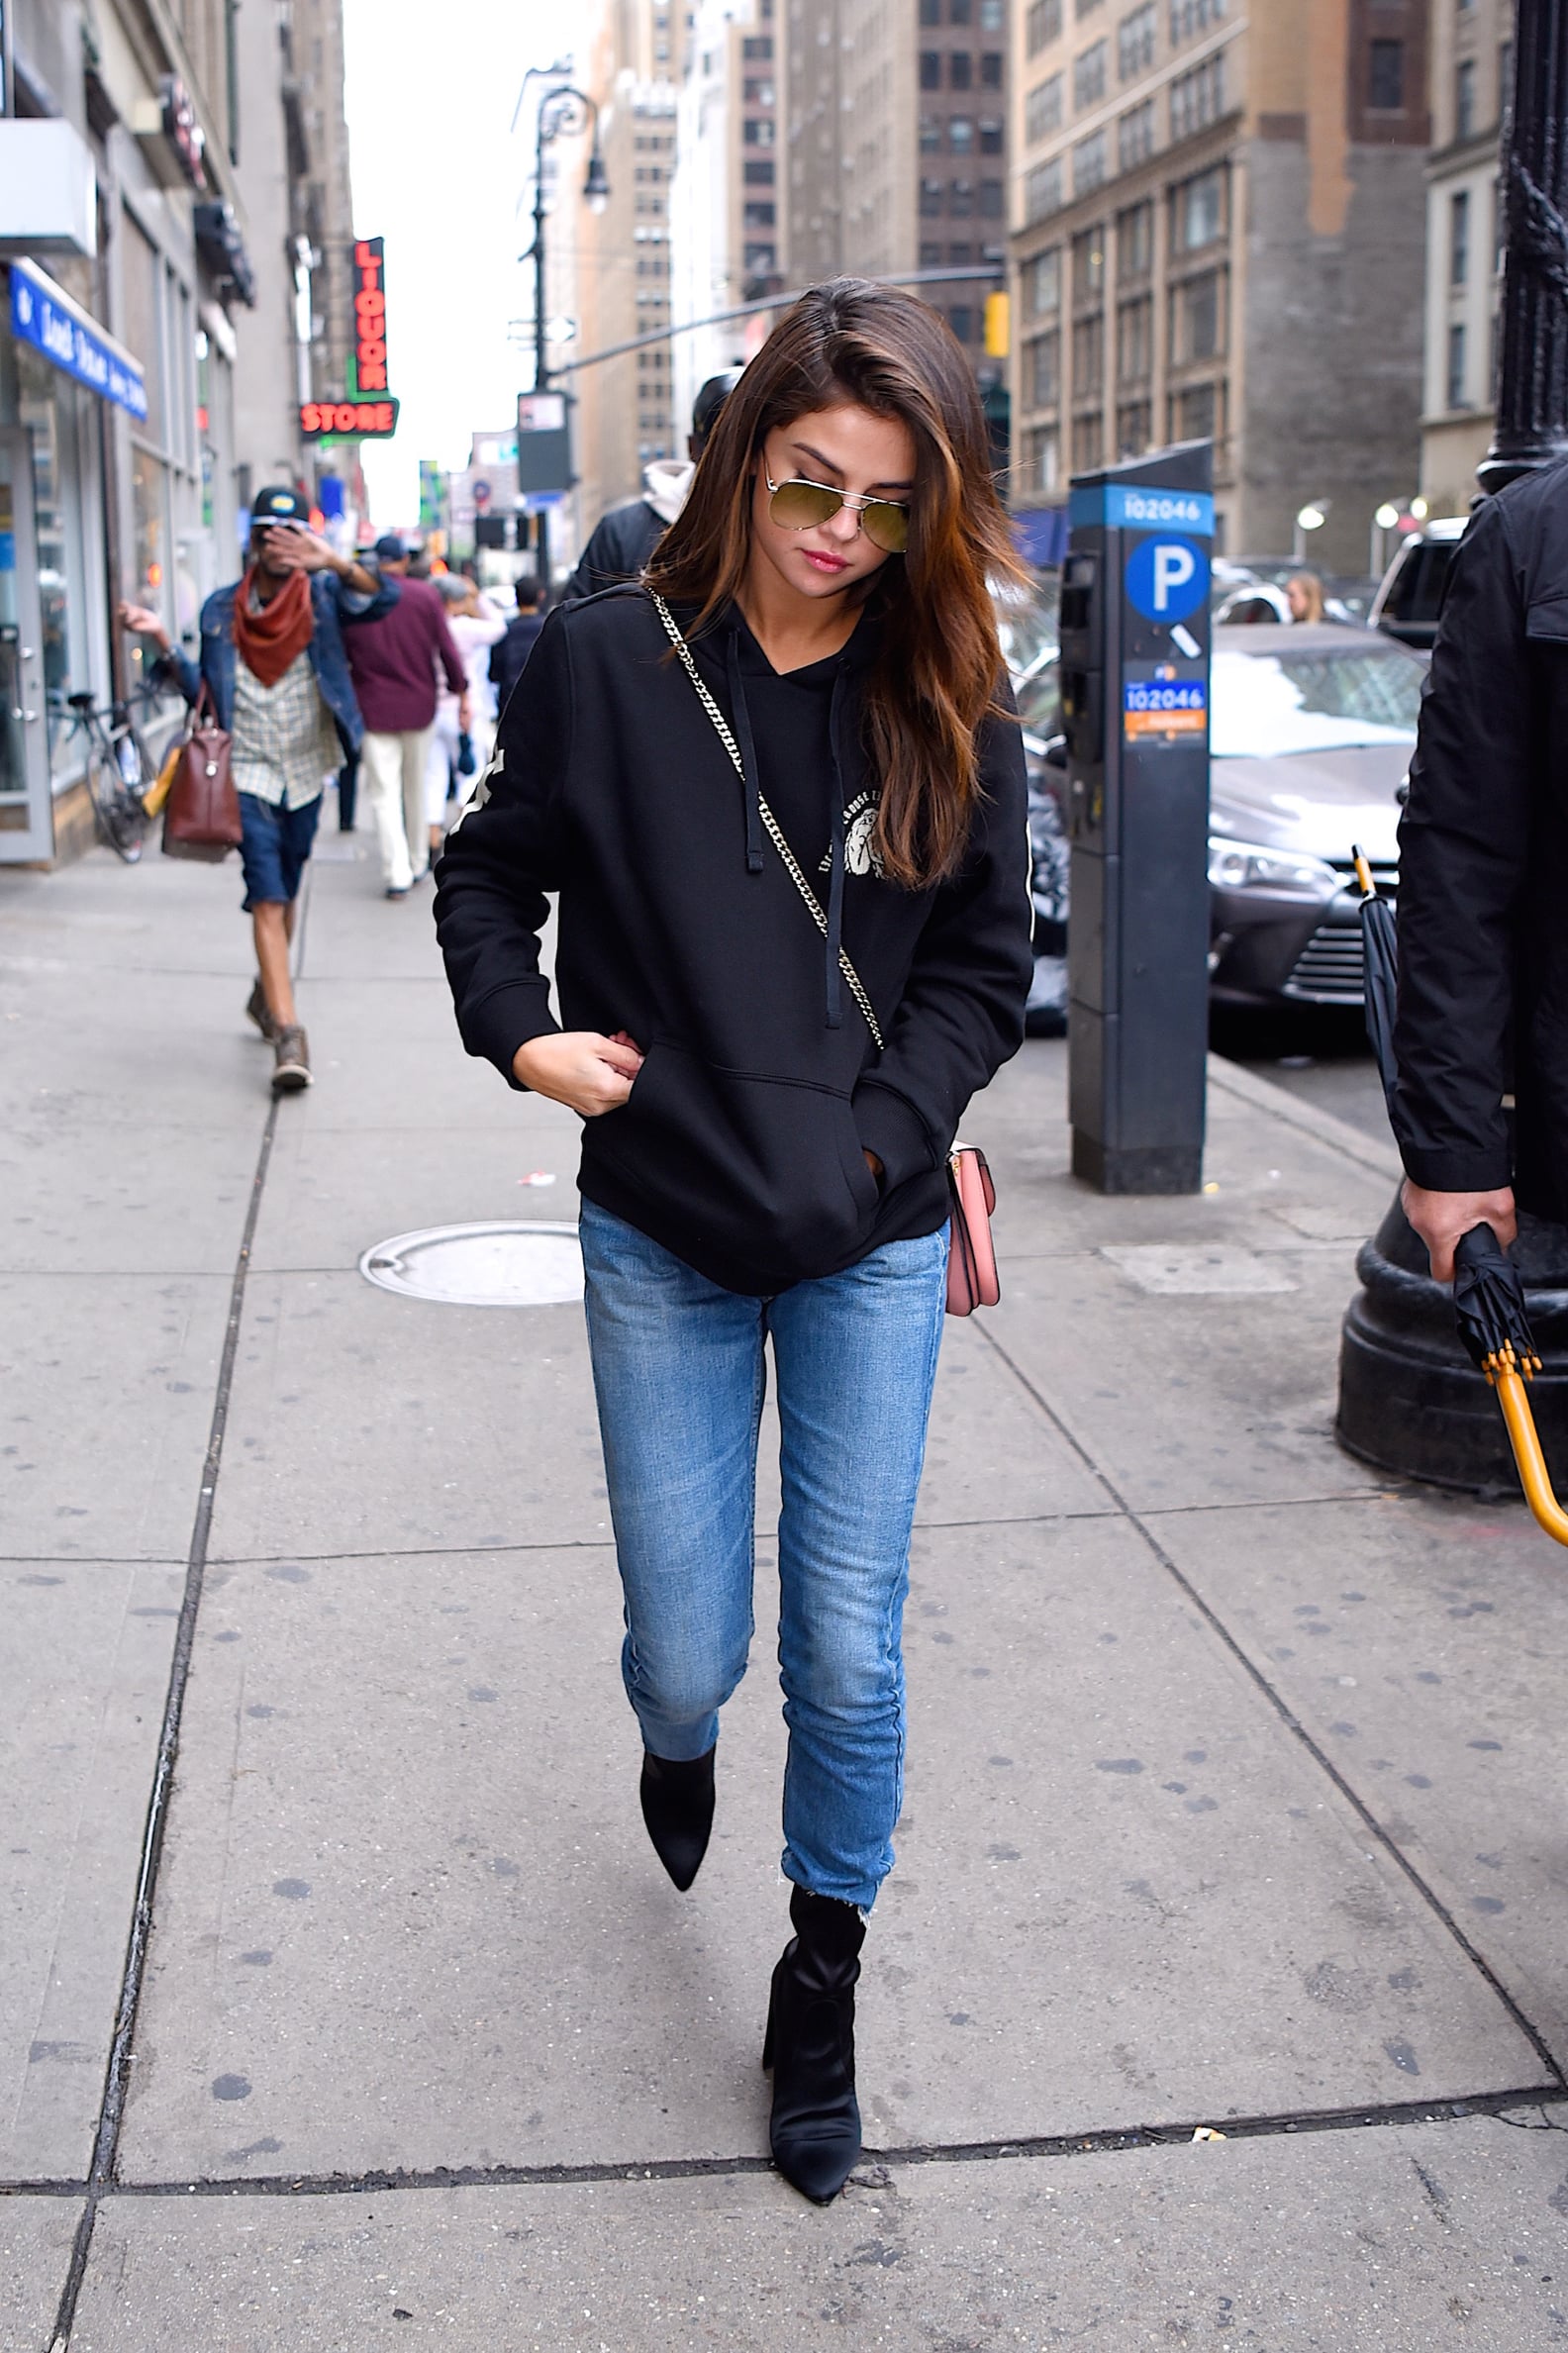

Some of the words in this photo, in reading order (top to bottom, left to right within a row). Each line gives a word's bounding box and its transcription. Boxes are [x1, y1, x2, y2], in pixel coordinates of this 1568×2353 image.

[355, 241, 387, 390] LIQUOR
[301, 403, 393, 432] STORE
[1124, 497, 1201, 521] 102046
[1153, 544, 1195, 611] P
[1127, 688, 1203, 710] 102046
